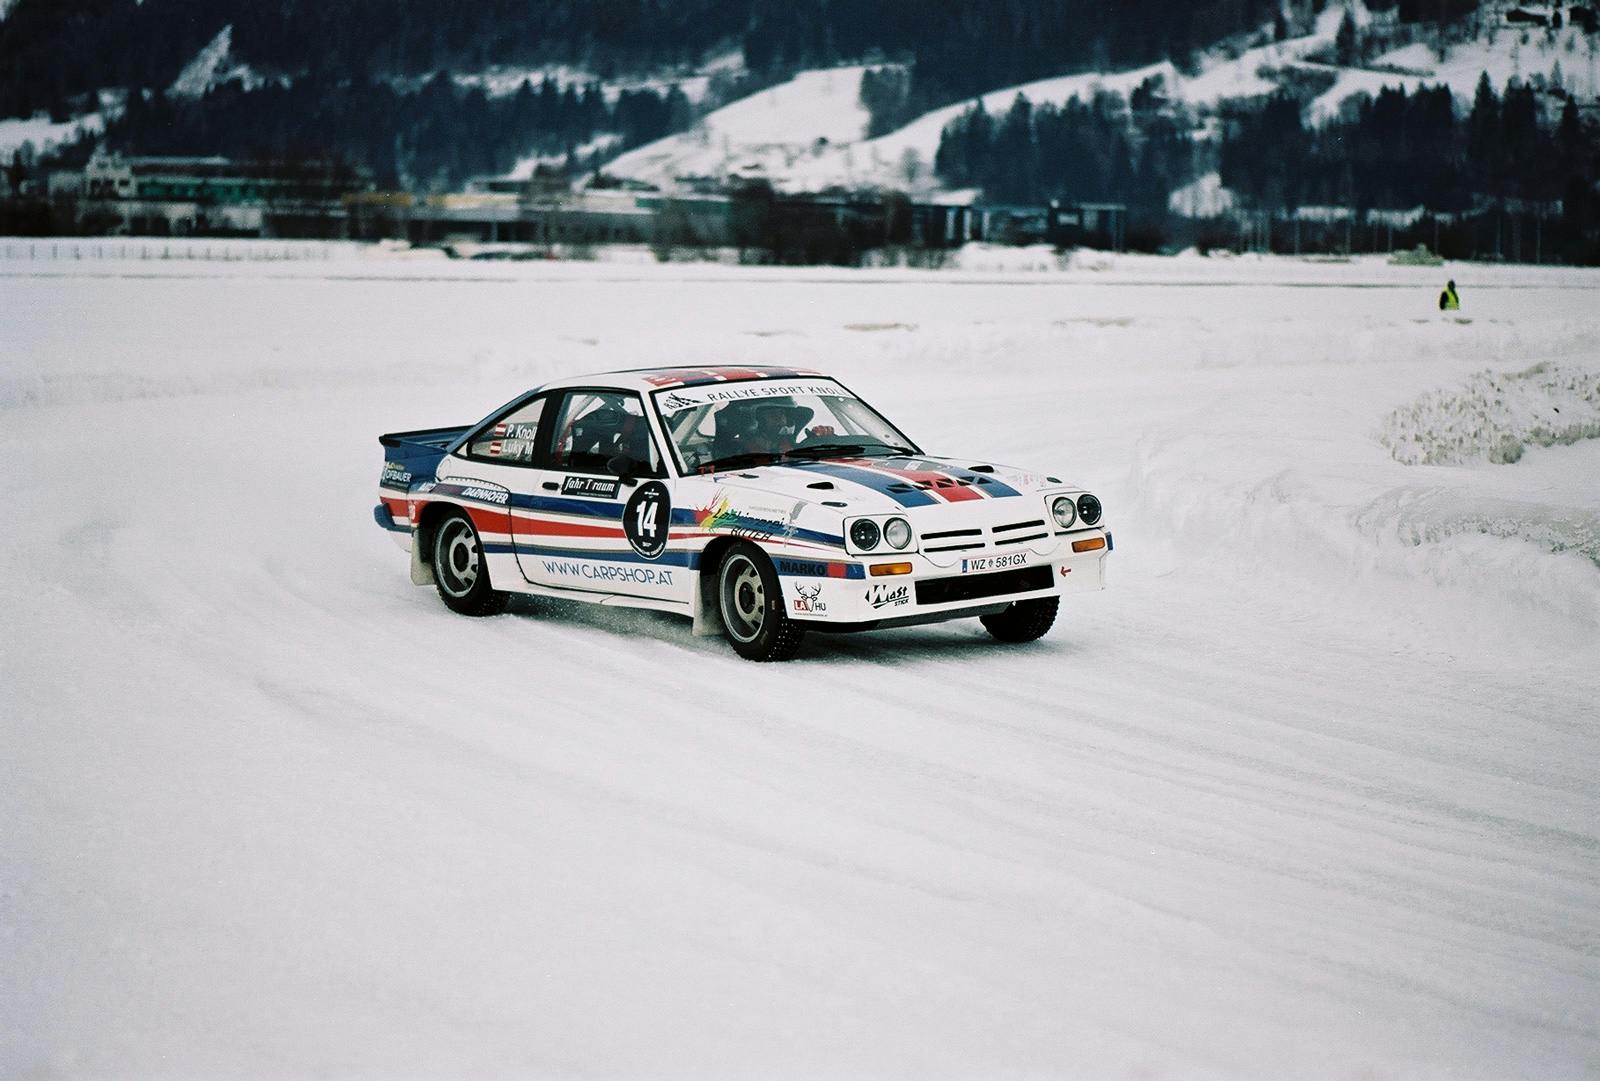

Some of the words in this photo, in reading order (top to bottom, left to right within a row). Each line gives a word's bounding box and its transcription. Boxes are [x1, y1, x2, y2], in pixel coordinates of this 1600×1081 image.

[707, 388, 758, 402] RALLYE
[761, 386, 807, 396] SPORT
[636, 501, 658, 538] 14
[780, 560, 826, 576] MARKO
[971, 559, 986, 570] WZ
[996, 553, 1027, 568] 581GX
